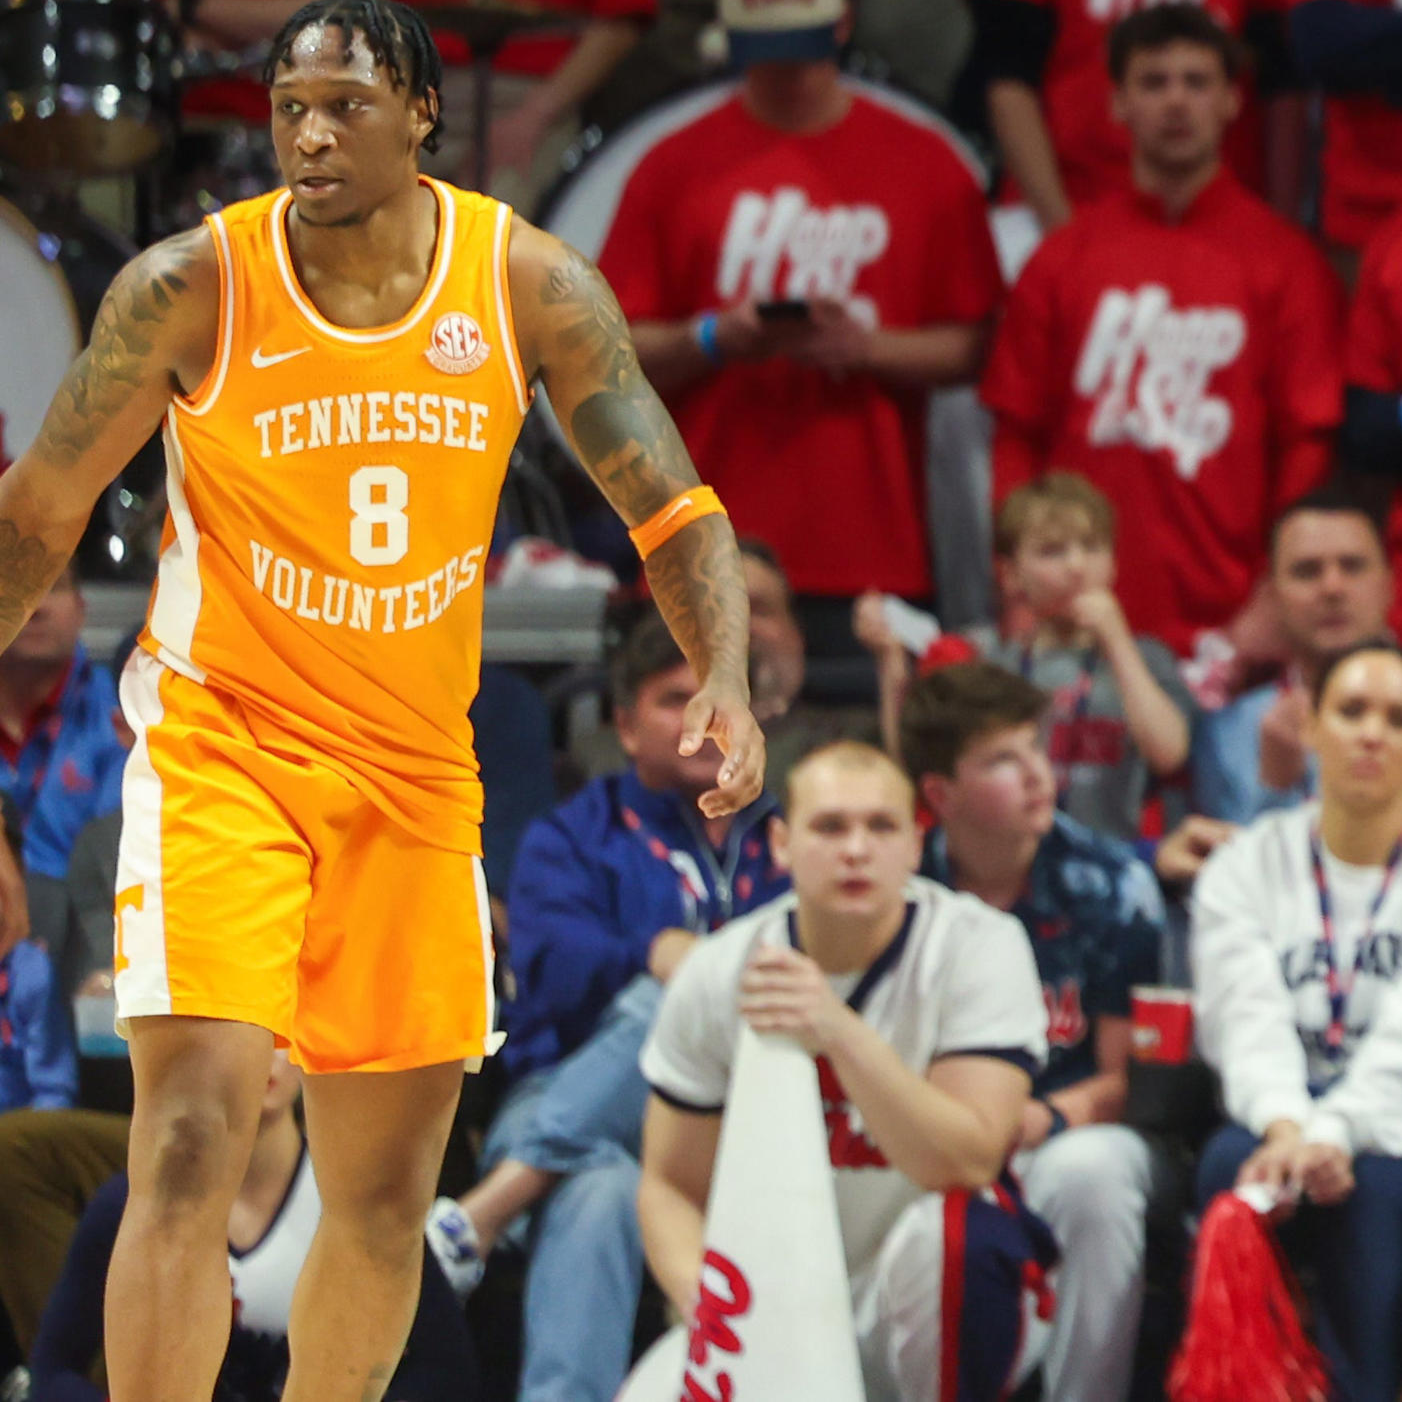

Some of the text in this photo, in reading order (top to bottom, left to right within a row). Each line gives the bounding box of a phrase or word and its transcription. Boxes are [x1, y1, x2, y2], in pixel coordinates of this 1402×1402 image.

[434, 313, 480, 360] SEC
[254, 392, 489, 458] TENNESSEE
[349, 465, 409, 566] 8
[250, 539, 484, 633] VOLUNTEERS
